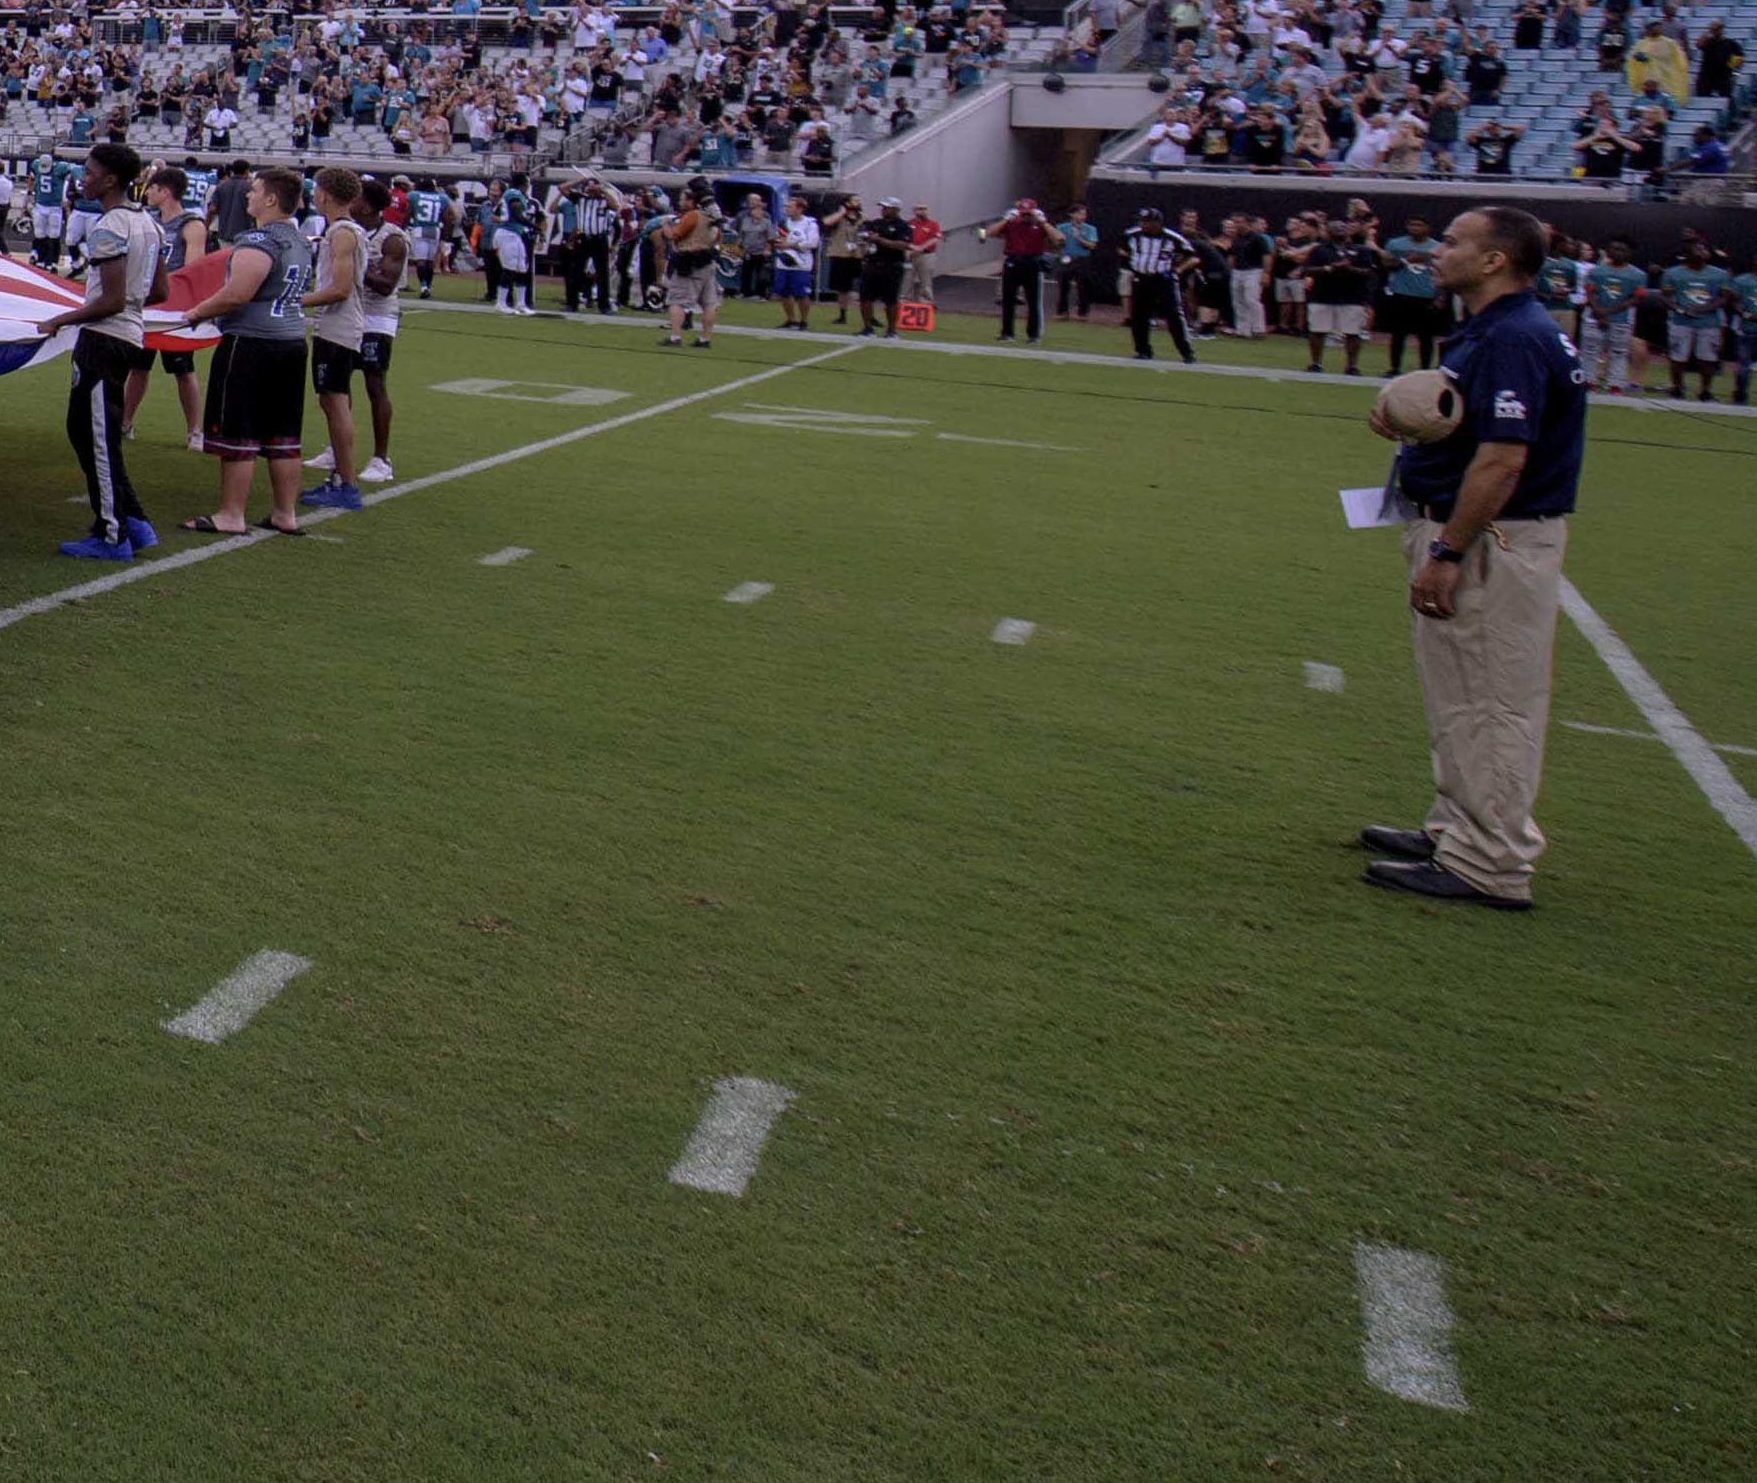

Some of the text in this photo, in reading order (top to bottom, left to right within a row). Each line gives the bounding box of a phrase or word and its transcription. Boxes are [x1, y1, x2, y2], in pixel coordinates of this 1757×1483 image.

[40, 175, 52, 193] 5
[417, 200, 441, 222] 31
[902, 305, 929, 327] 20
